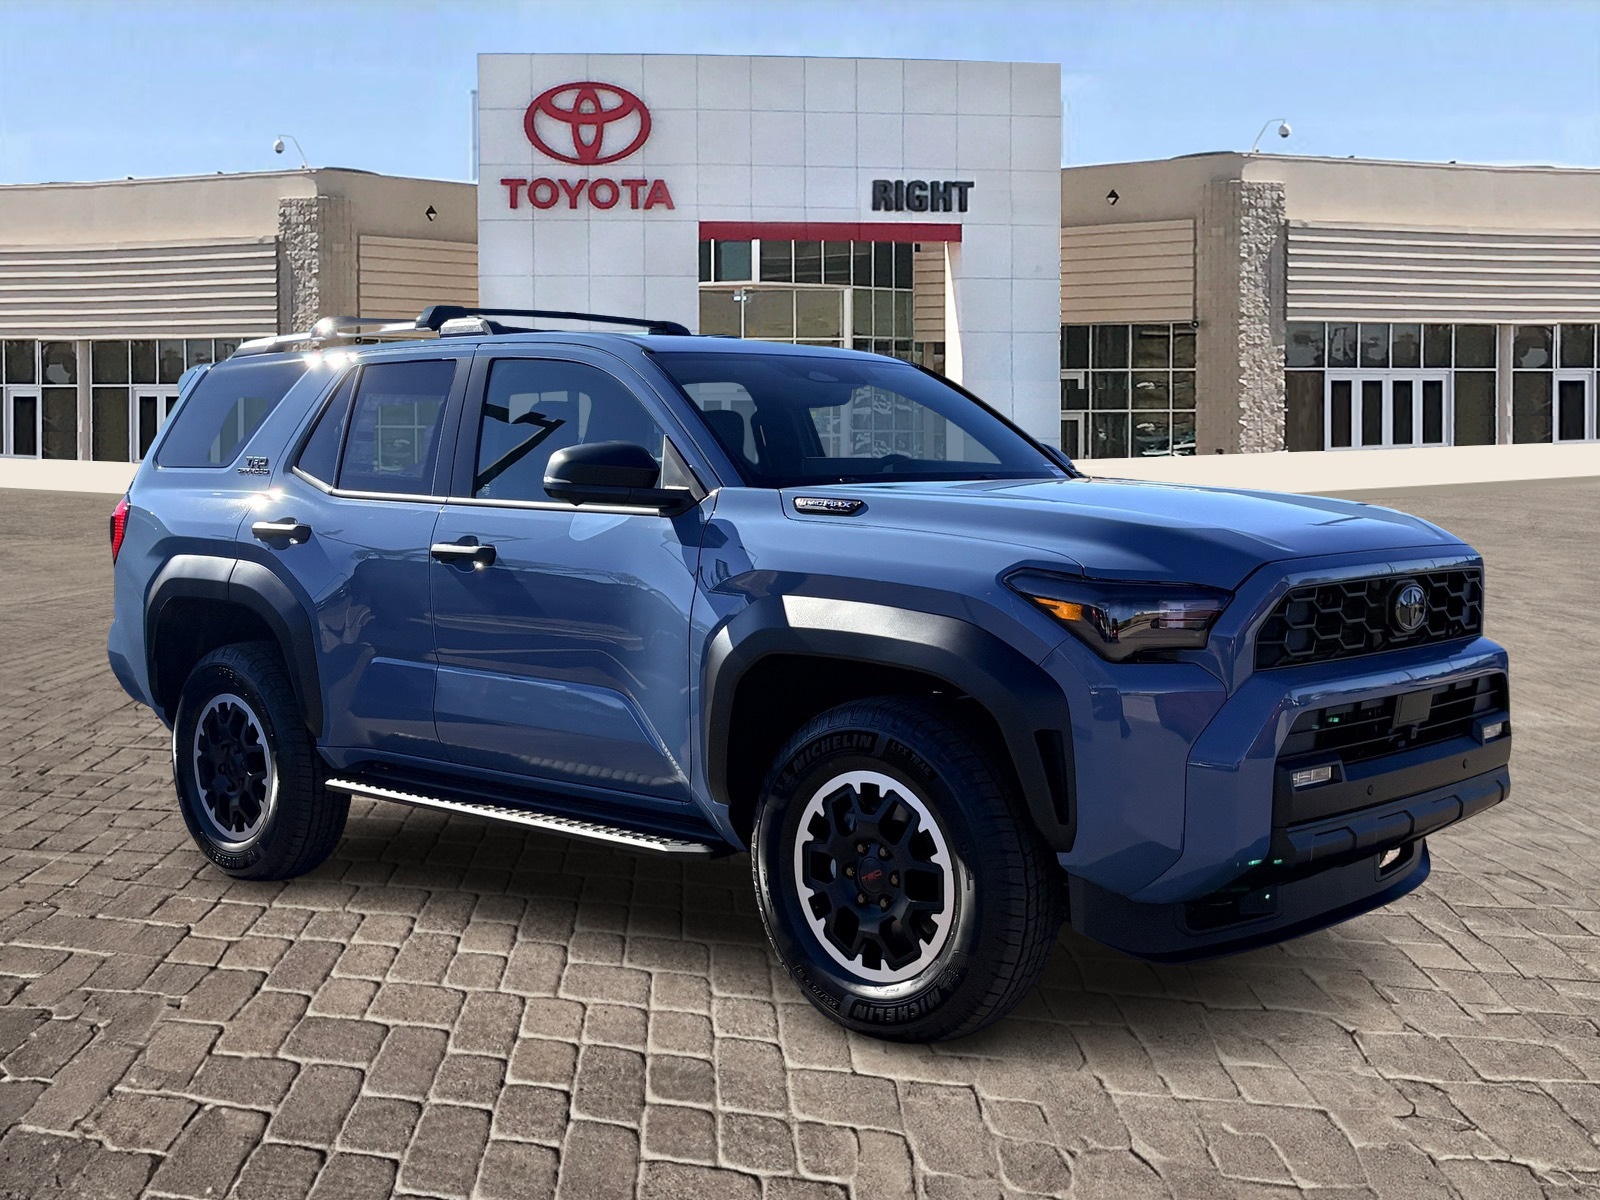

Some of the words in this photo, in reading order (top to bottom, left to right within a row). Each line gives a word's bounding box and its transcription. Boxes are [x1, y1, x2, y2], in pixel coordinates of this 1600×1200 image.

[500, 178, 675, 210] TOYOTA
[871, 179, 975, 213] RIGHT
[791, 733, 873, 775] MICHELIN
[889, 741, 910, 758] LTX
[908, 753, 934, 778] TRAIL
[851, 988, 942, 1024] MICHELIN
